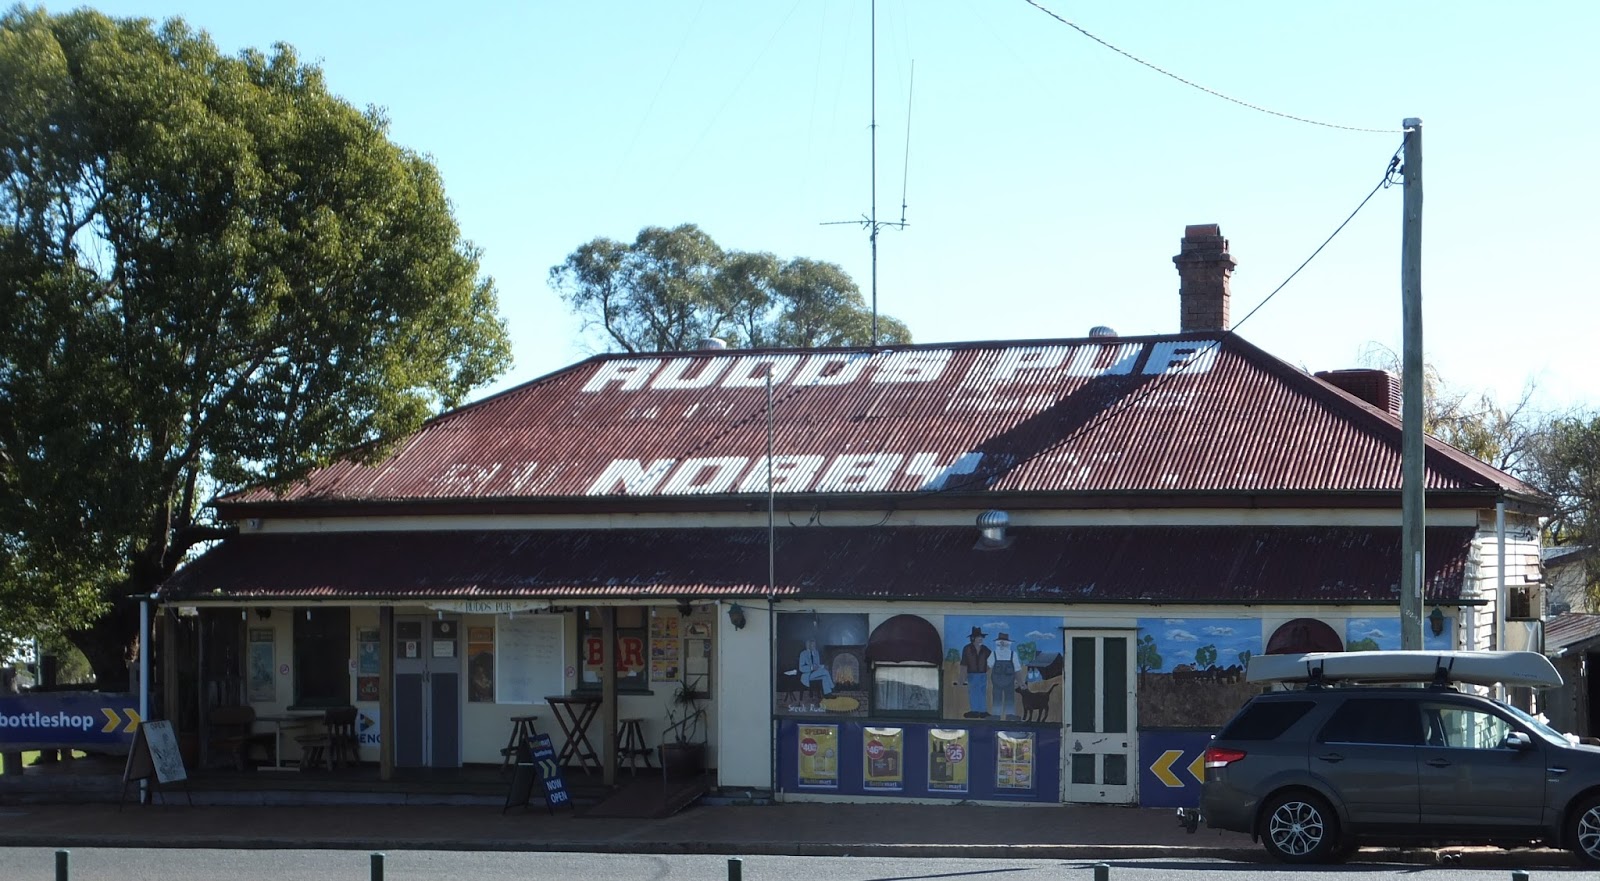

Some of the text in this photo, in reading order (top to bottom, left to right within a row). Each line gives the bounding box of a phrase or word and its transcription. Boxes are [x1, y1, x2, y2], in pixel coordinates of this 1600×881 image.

[975, 340, 1222, 380] PUB
[585, 451, 984, 496] NOBBY
[495, 602, 512, 611] PUB
[586, 638, 645, 672] BAR
[0, 712, 94, 731] bottleshop
[946, 749, 963, 760] $25
[546, 779, 562, 791] NOW
[550, 791, 568, 803] OPEN
